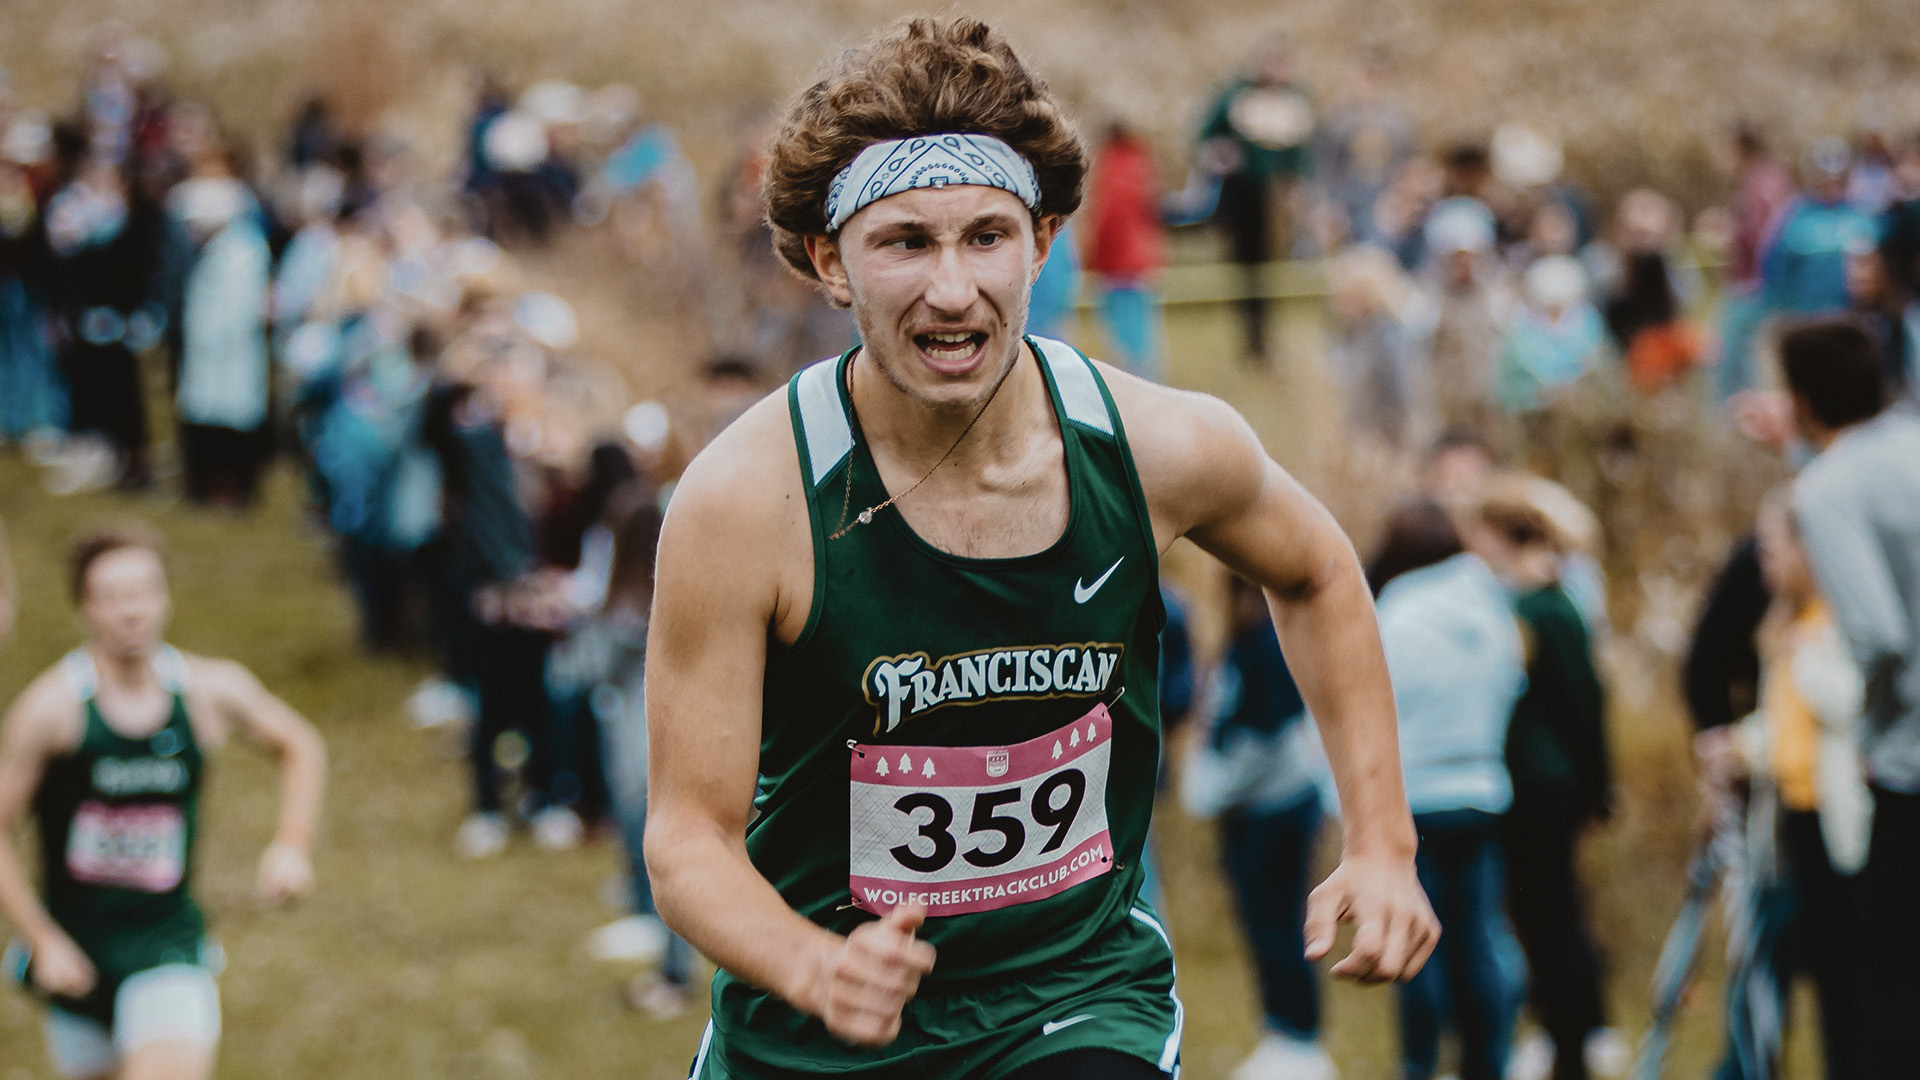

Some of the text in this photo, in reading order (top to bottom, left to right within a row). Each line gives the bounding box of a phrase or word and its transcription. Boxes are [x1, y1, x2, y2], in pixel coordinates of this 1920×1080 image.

[874, 649, 1118, 733] FRANCISCAN
[889, 768, 1087, 873] 359
[863, 843, 1104, 906] WOLFCREEKTRACKCLUB.COM
